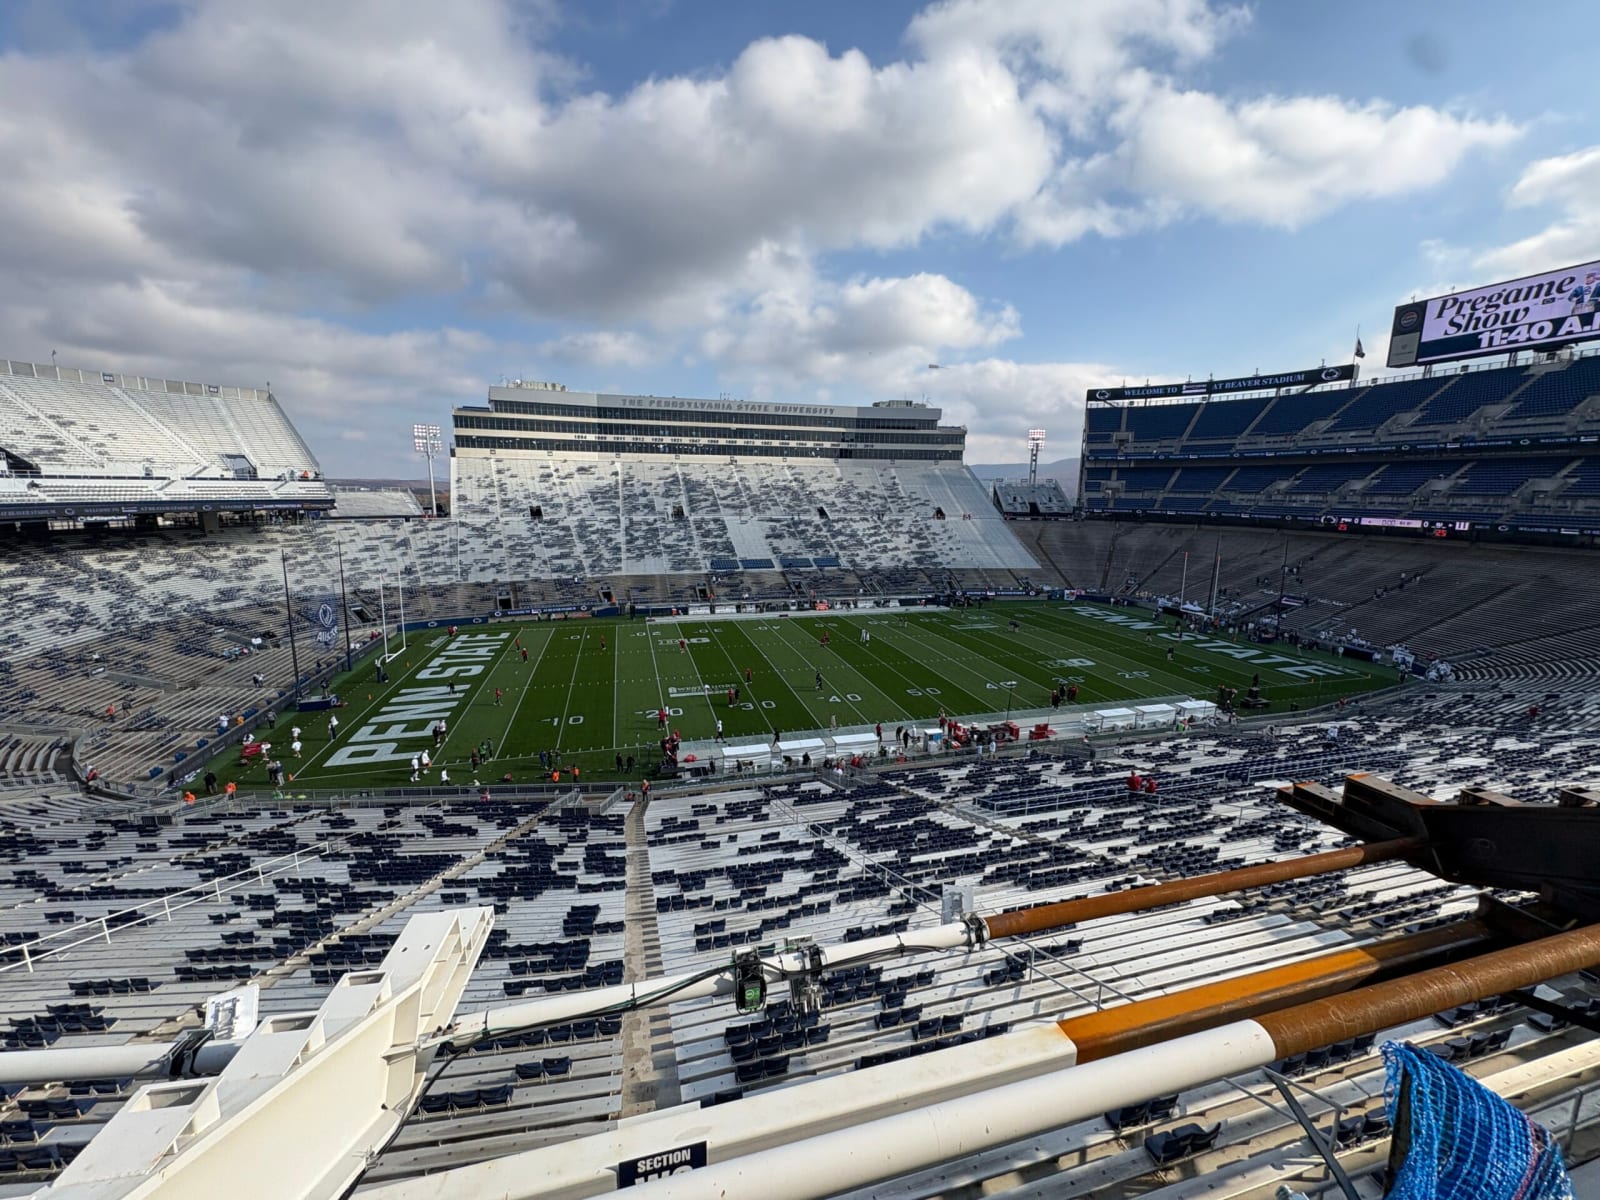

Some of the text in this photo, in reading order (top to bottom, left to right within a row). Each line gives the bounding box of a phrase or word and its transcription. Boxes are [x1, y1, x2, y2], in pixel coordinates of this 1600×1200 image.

[1434, 275, 1576, 320] Pregame
[1443, 306, 1530, 336] Show
[1478, 319, 1553, 348] 11:40
[1124, 387, 1165, 397] WELCOME
[1166, 386, 1178, 395] TO
[1212, 381, 1224, 391] AT
[1224, 378, 1261, 390] BEAVER
[1262, 373, 1305, 387] STADIUM
[622, 398, 835, 415] THE PENNSYLVANIA STATE UNIVERSITY
[1058, 606, 1345, 678] PENN STATE
[415, 632, 512, 680] STATE
[829, 693, 862, 703] 40
[906, 687, 942, 697] 50
[740, 701, 777, 711] 30
[322, 683, 472, 768] PENN
[551, 715, 585, 727] 10
[637, 1148, 691, 1173] SECTION
